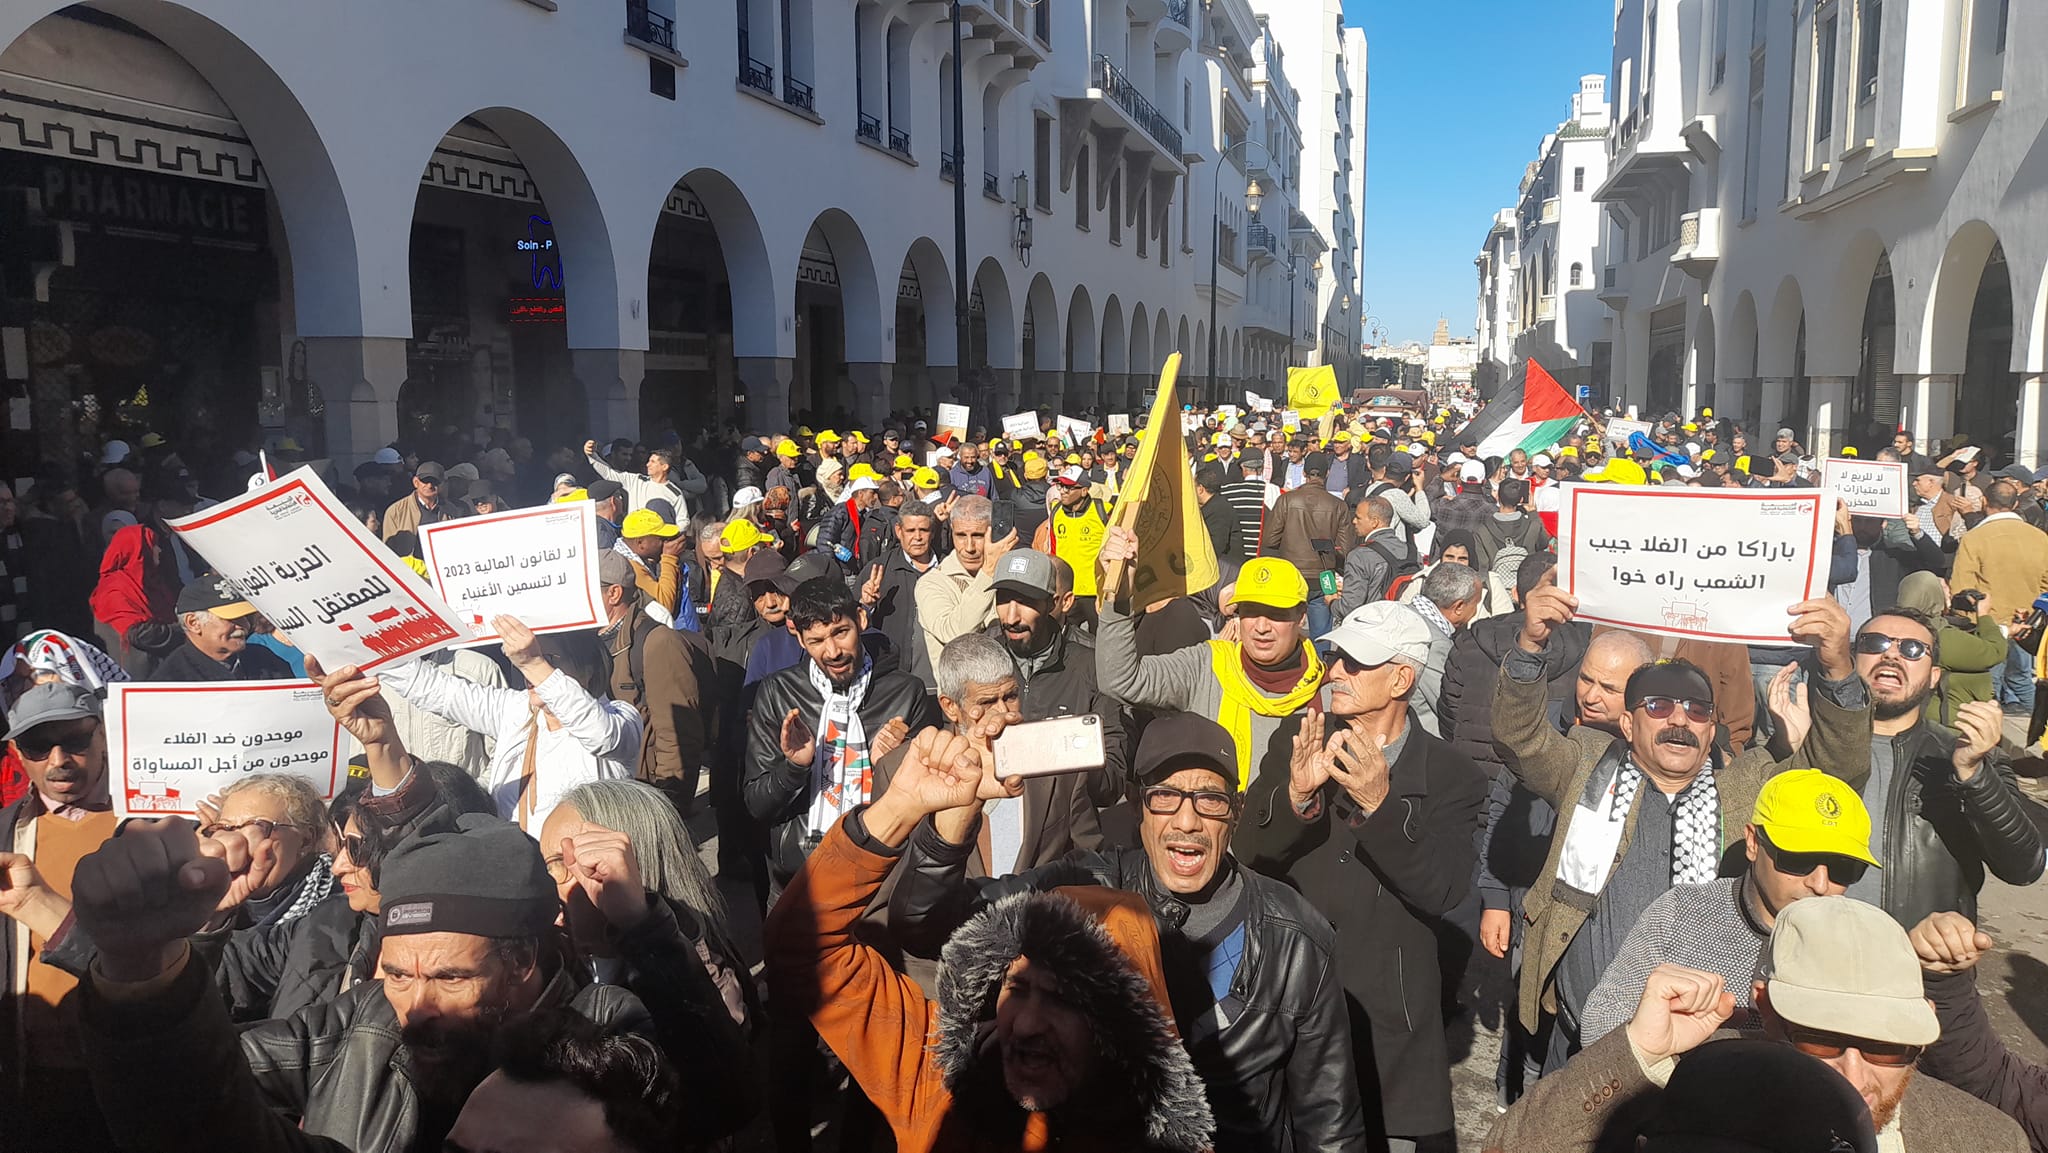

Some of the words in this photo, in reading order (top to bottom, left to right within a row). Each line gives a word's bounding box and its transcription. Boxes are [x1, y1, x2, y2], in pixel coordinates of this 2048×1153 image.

[44, 165, 250, 232] PHARMACIE
[517, 240, 539, 250] Soin
[566, 546, 576, 559] لا
[1589, 538, 1632, 554] جيب
[1640, 535, 1687, 554] الغلا
[1696, 545, 1727, 560] من
[1738, 540, 1795, 562] باراكا
[269, 544, 332, 582] الحرية
[474, 555, 515, 574] المالية
[520, 548, 561, 569] لقانون
[443, 563, 471, 578] 2023
[557, 572, 567, 586] لا
[1612, 566, 1646, 586] خوا
[506, 574, 552, 597] لتسمين
[1655, 570, 1684, 591] راه
[1693, 574, 1765, 592] الشعب
[312, 575, 392, 625] للمعتقل
[462, 582, 503, 601] الأغنياء
[163, 732, 207, 744] الغلاء
[212, 732, 236, 744] ضد
[241, 730, 303, 747] موحدون
[133, 757, 202, 774] المساواة
[208, 755, 237, 774] أجل
[242, 758, 265, 772] من
[269, 750, 329, 769] موحدون
